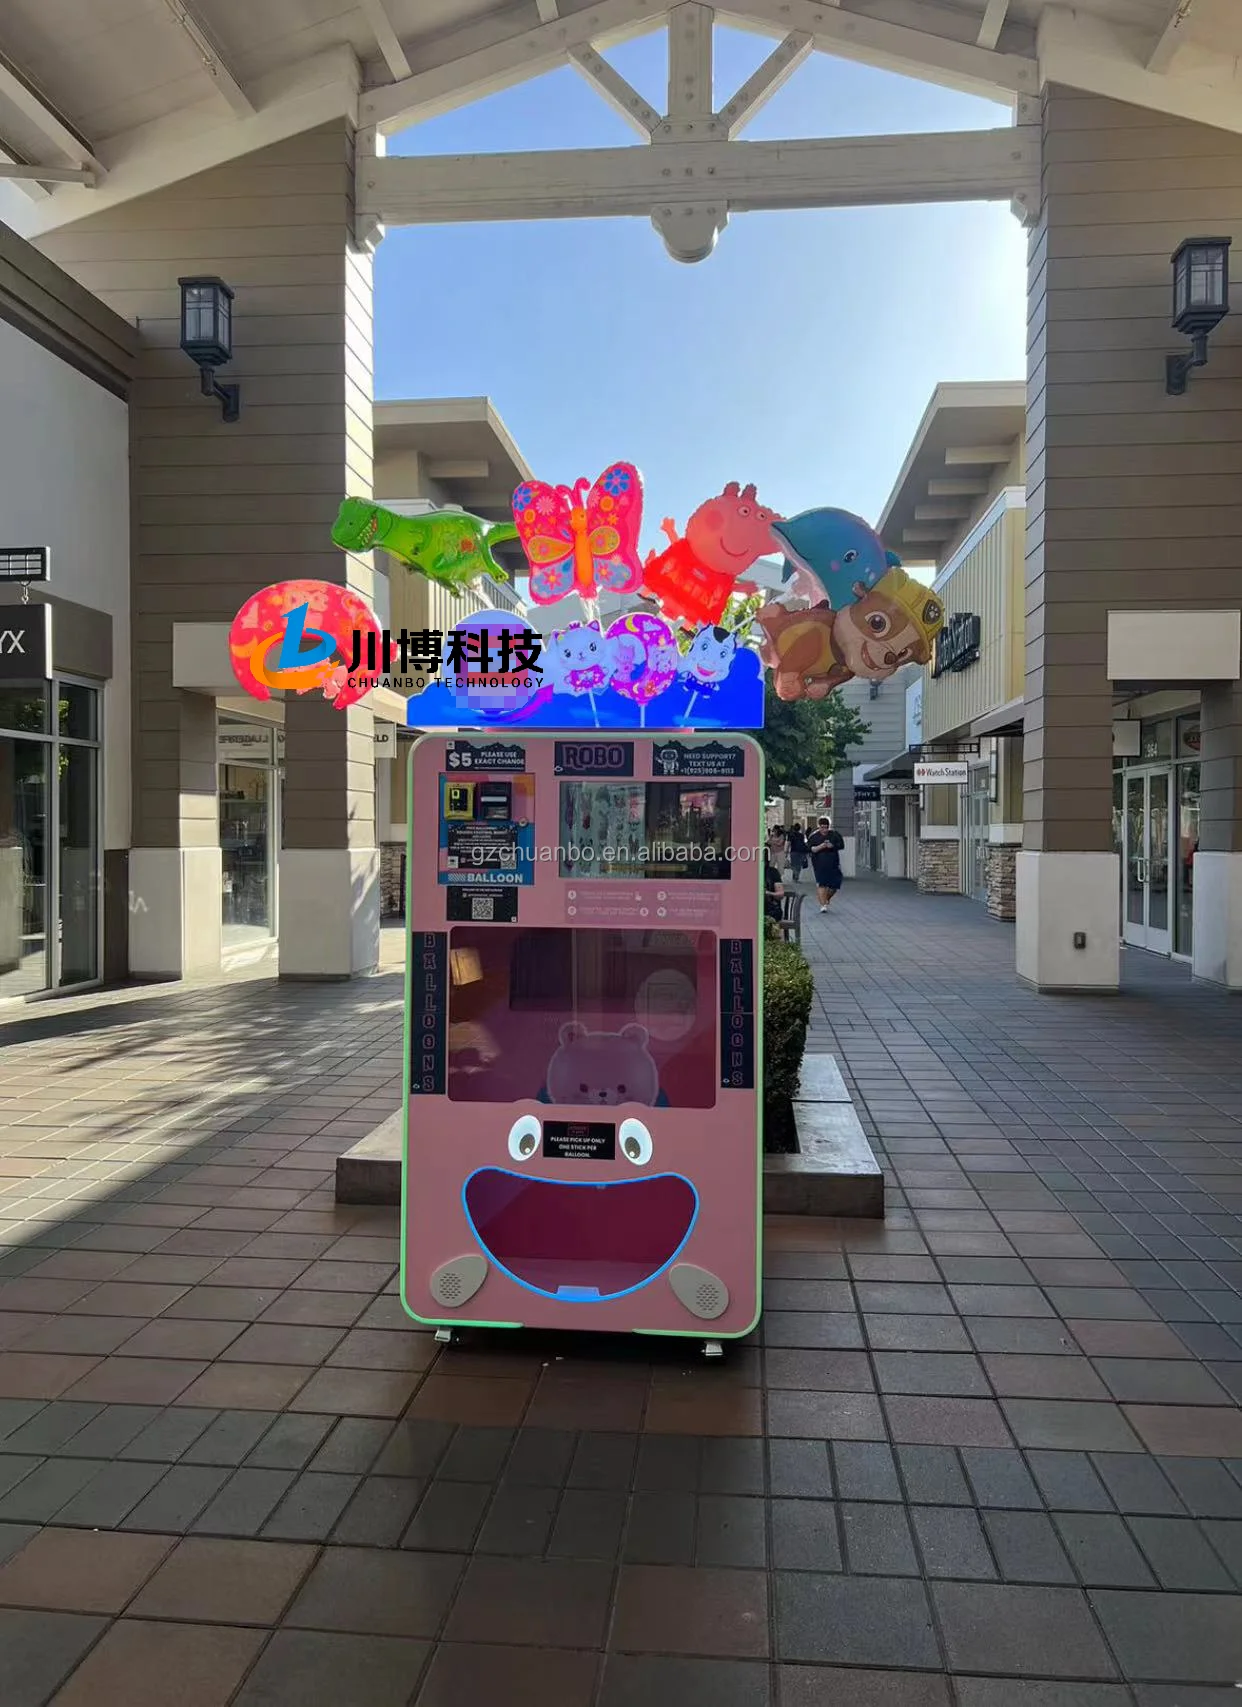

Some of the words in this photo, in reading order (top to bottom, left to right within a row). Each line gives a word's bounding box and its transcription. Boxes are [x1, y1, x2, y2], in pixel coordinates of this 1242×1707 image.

[448, 751, 473, 768] $5
[562, 744, 625, 770] ROBO
[926, 767, 944, 777] Watch
[944, 767, 967, 777] Station
[467, 873, 524, 883] BALLOON
[422, 933, 437, 1091] BALLOONS
[730, 939, 744, 1085] BALLOONS
